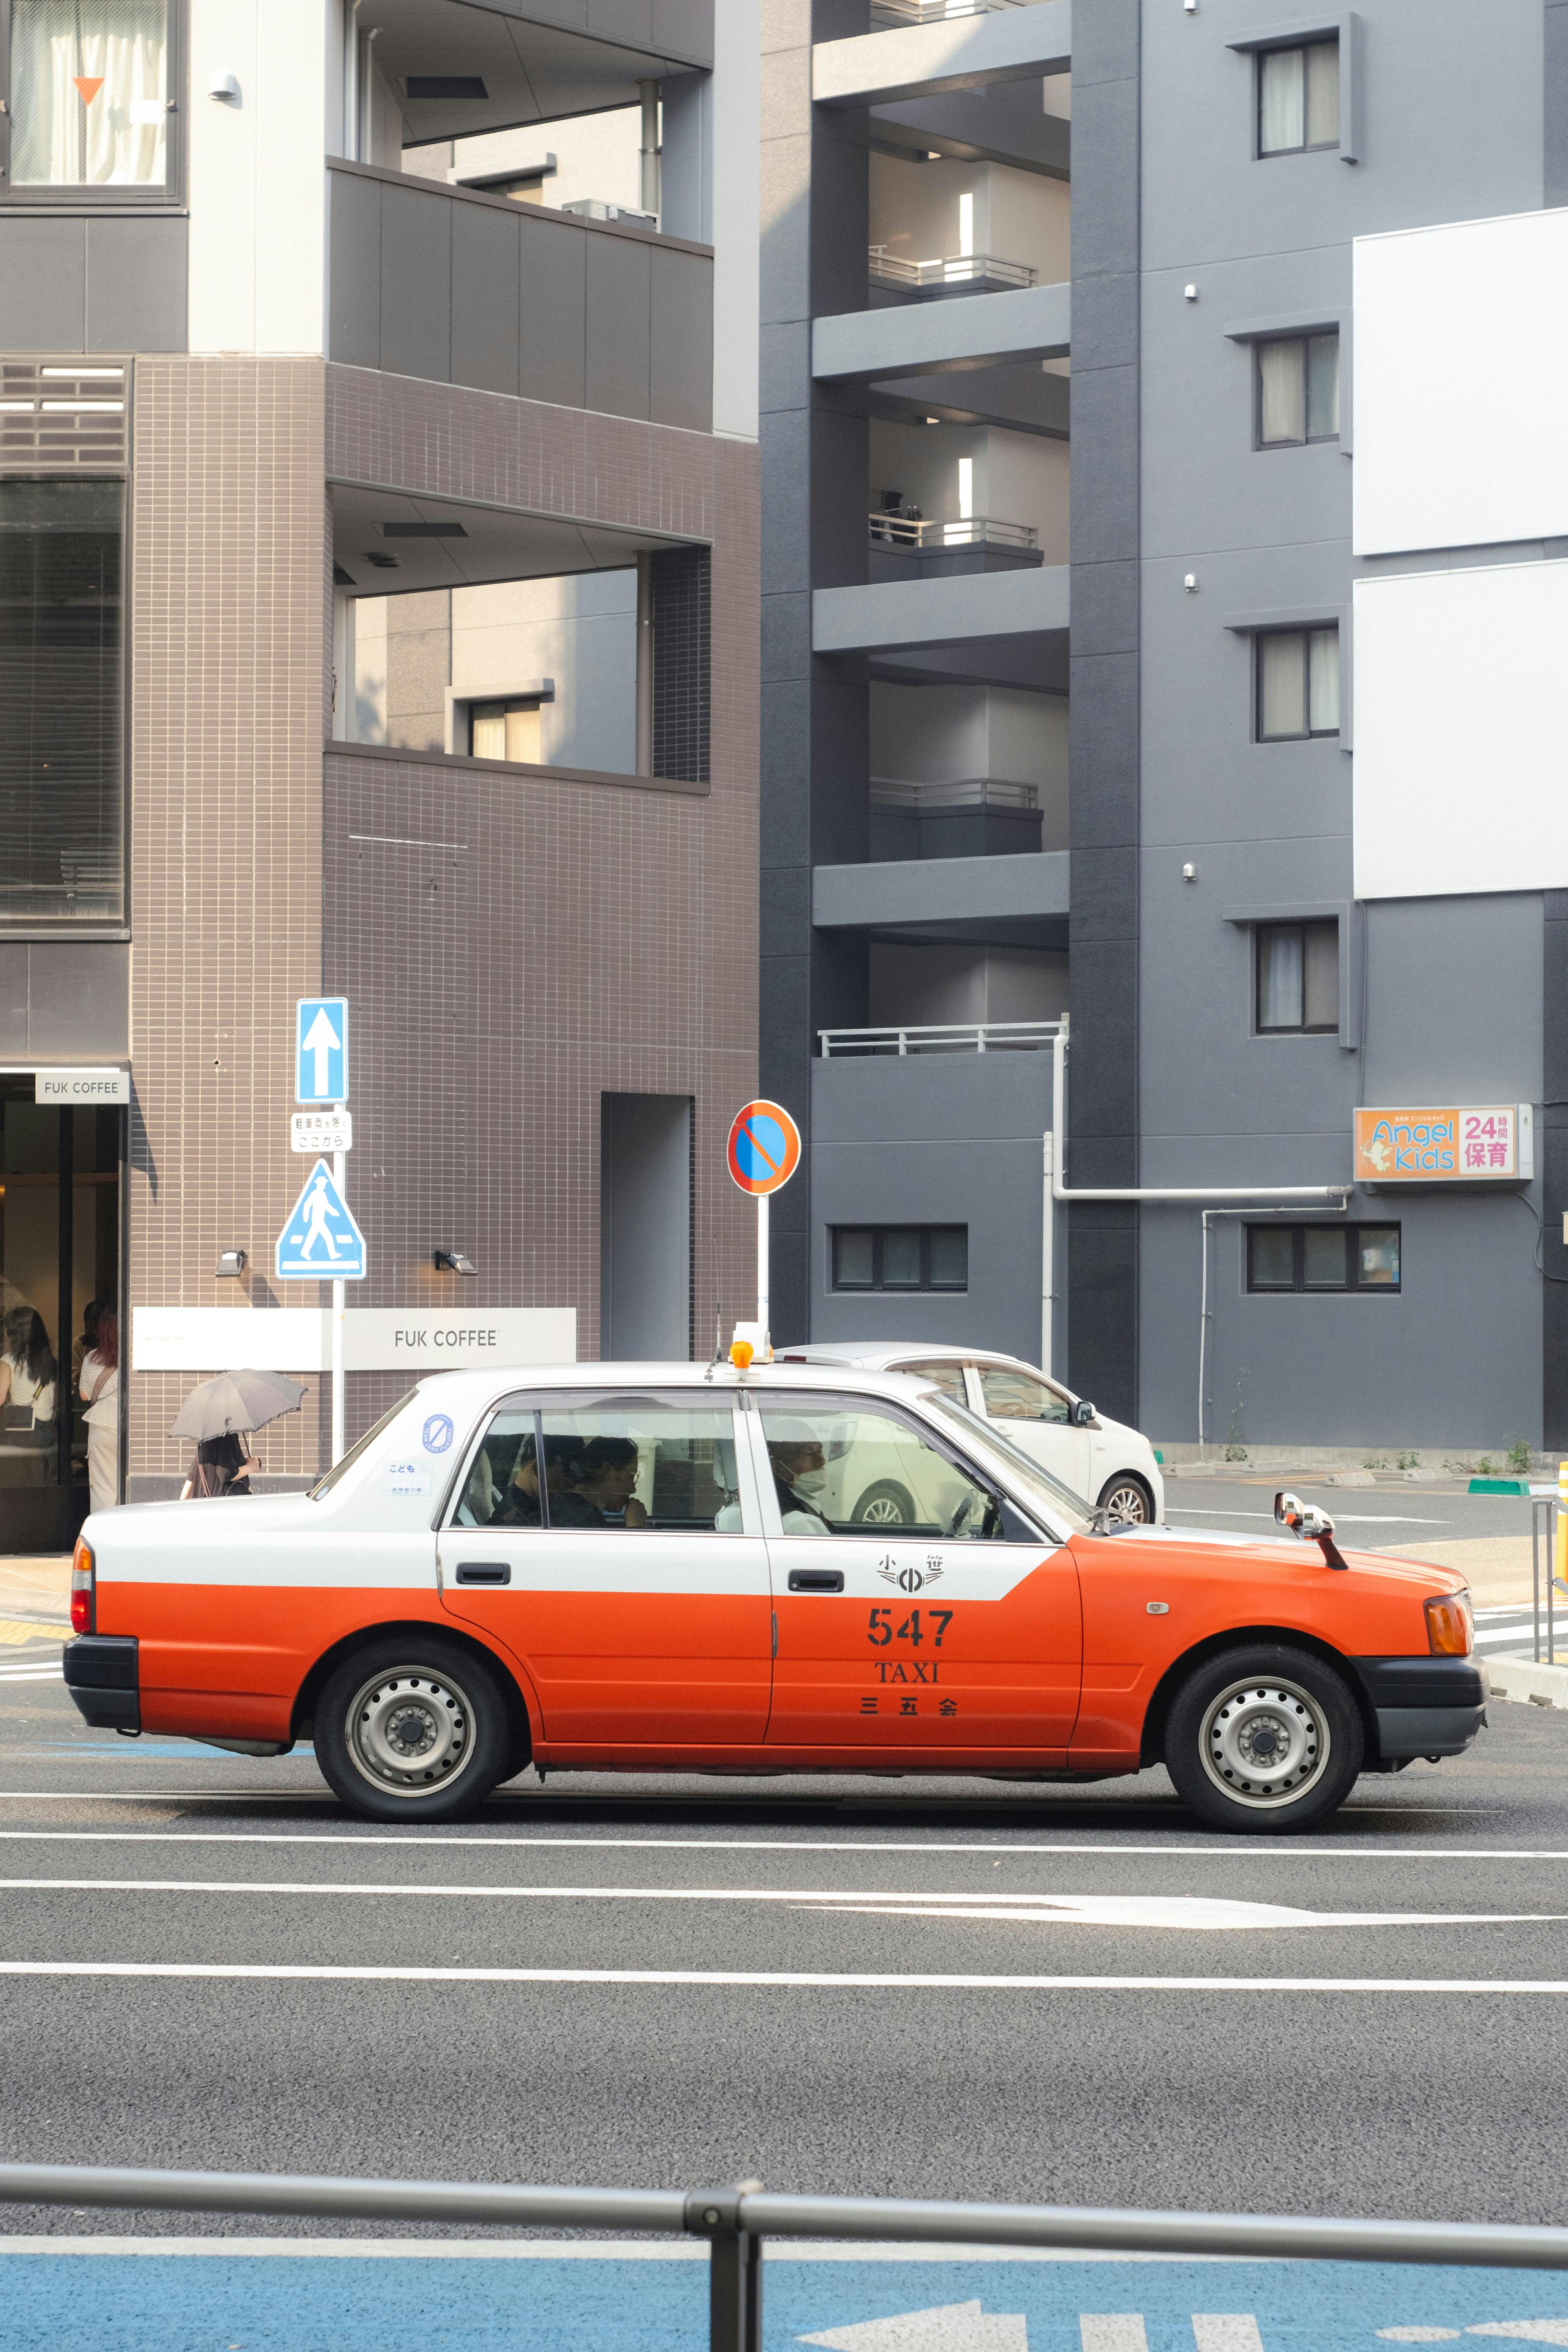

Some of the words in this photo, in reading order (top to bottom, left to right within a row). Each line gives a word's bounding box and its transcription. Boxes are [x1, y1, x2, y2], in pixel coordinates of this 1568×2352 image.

[45, 1082, 68, 1093] FUK
[73, 1082, 118, 1093] COFFEE
[296, 1117, 346, 1129] 軽車両を除く
[1372, 1120, 1453, 1147] Angel
[299, 1136, 343, 1147] ここから
[1395, 1147, 1454, 1170] Kids
[1465, 1142, 1507, 1168] 保育
[395, 1330, 427, 1347] FUK
[434, 1330, 496, 1346] COFFEE
[424, 1443, 438, 1452] ZERO
[439, 1428, 452, 1451] FUKUOKA
[389, 1464, 414, 1473] こども
[867, 1608, 953, 1647] 547
[874, 1662, 939, 1683] TAXI
